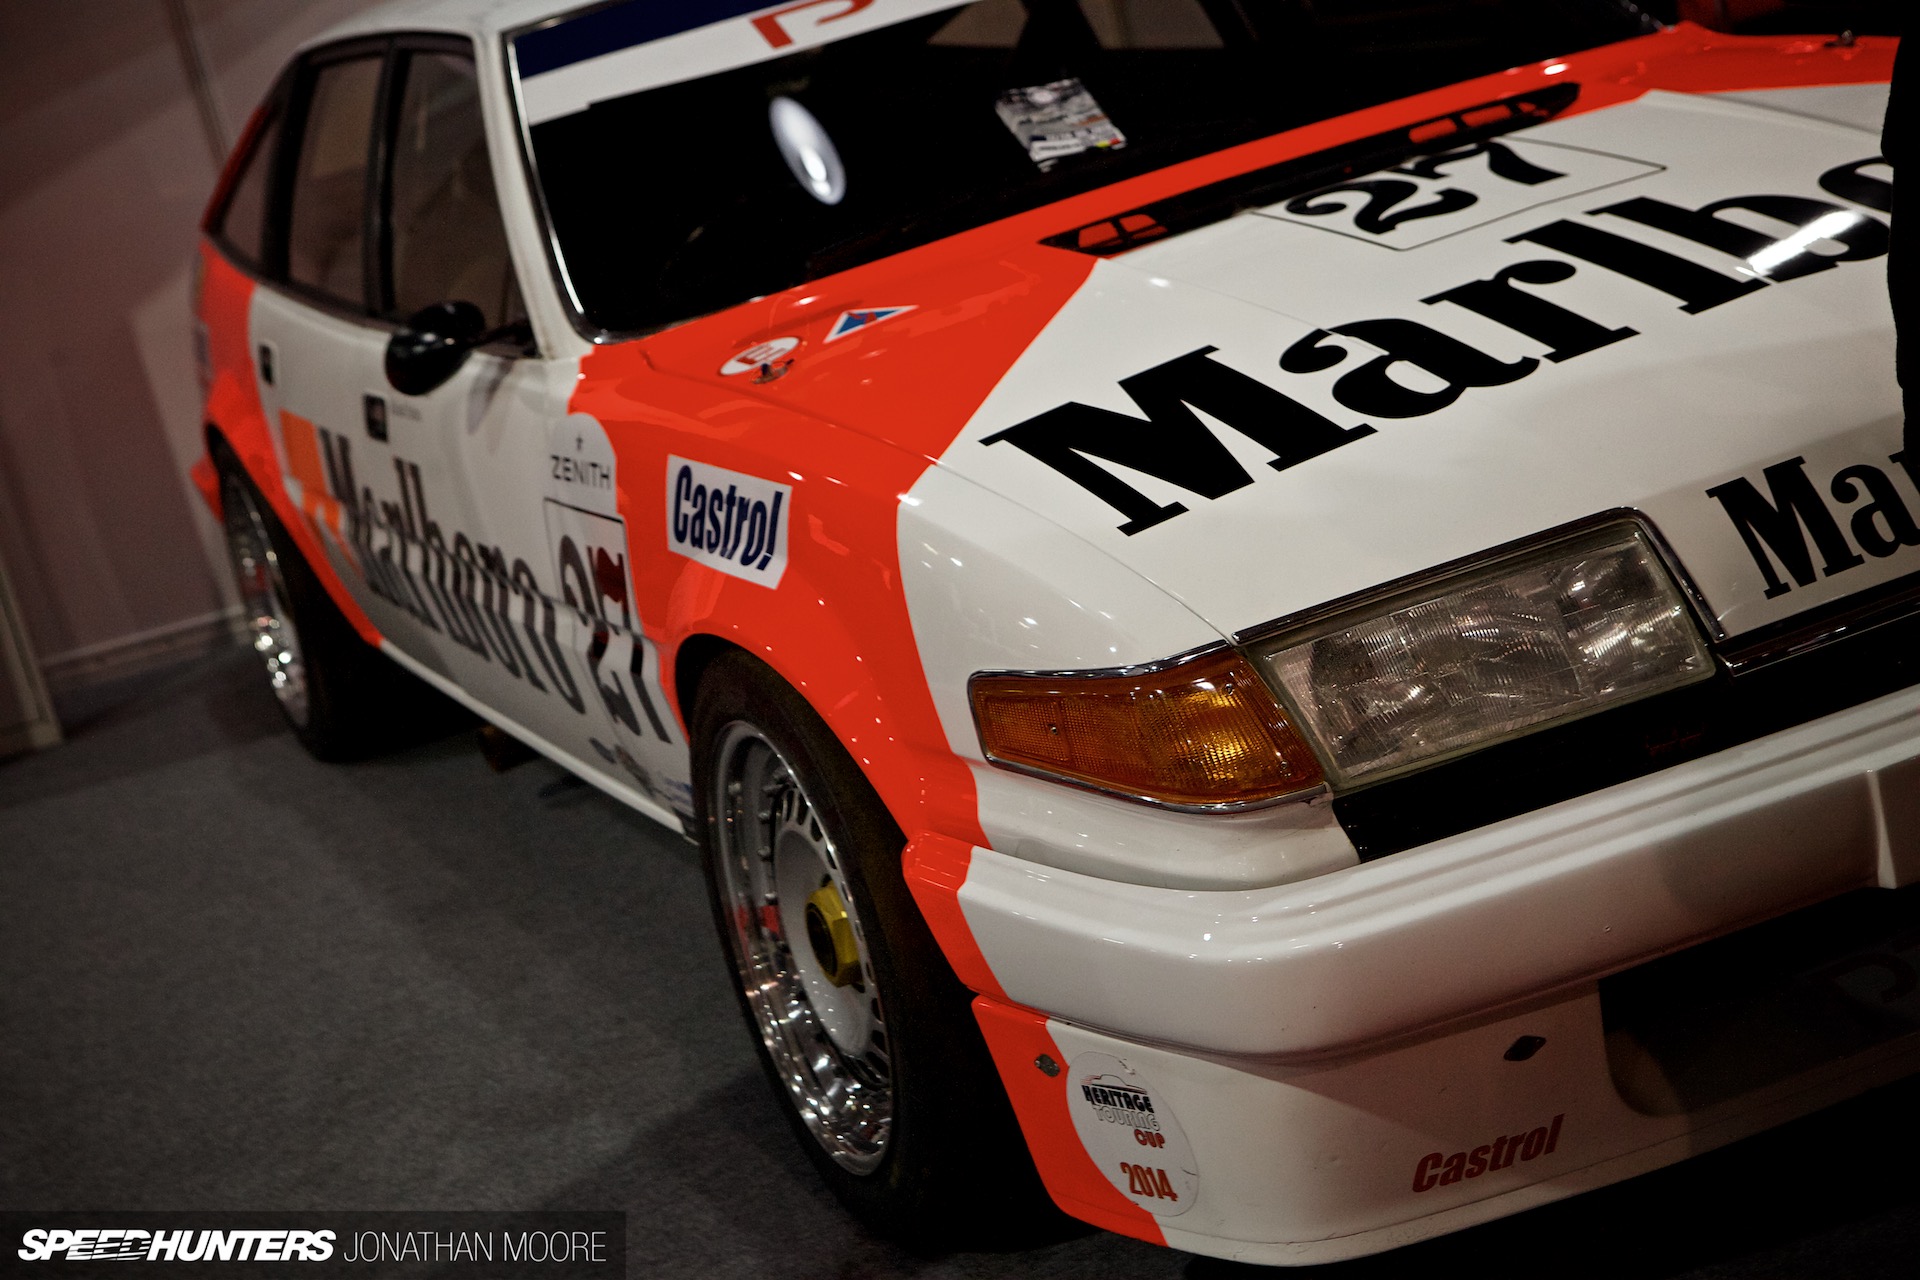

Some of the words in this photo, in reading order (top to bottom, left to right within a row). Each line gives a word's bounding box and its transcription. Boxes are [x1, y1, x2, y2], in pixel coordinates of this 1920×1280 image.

[1285, 141, 1569, 235] 27
[550, 454, 611, 490] ZENITH
[673, 464, 784, 571] Castrol
[1705, 450, 1920, 600] Ma
[318, 426, 587, 715] Marlboro
[1081, 1084, 1155, 1114] HERITAGE
[1092, 1102, 1161, 1132] TOURING
[1133, 1128, 1166, 1149] CUP
[1412, 1113, 1566, 1193] Castrol
[1119, 1161, 1179, 1202] 2014
